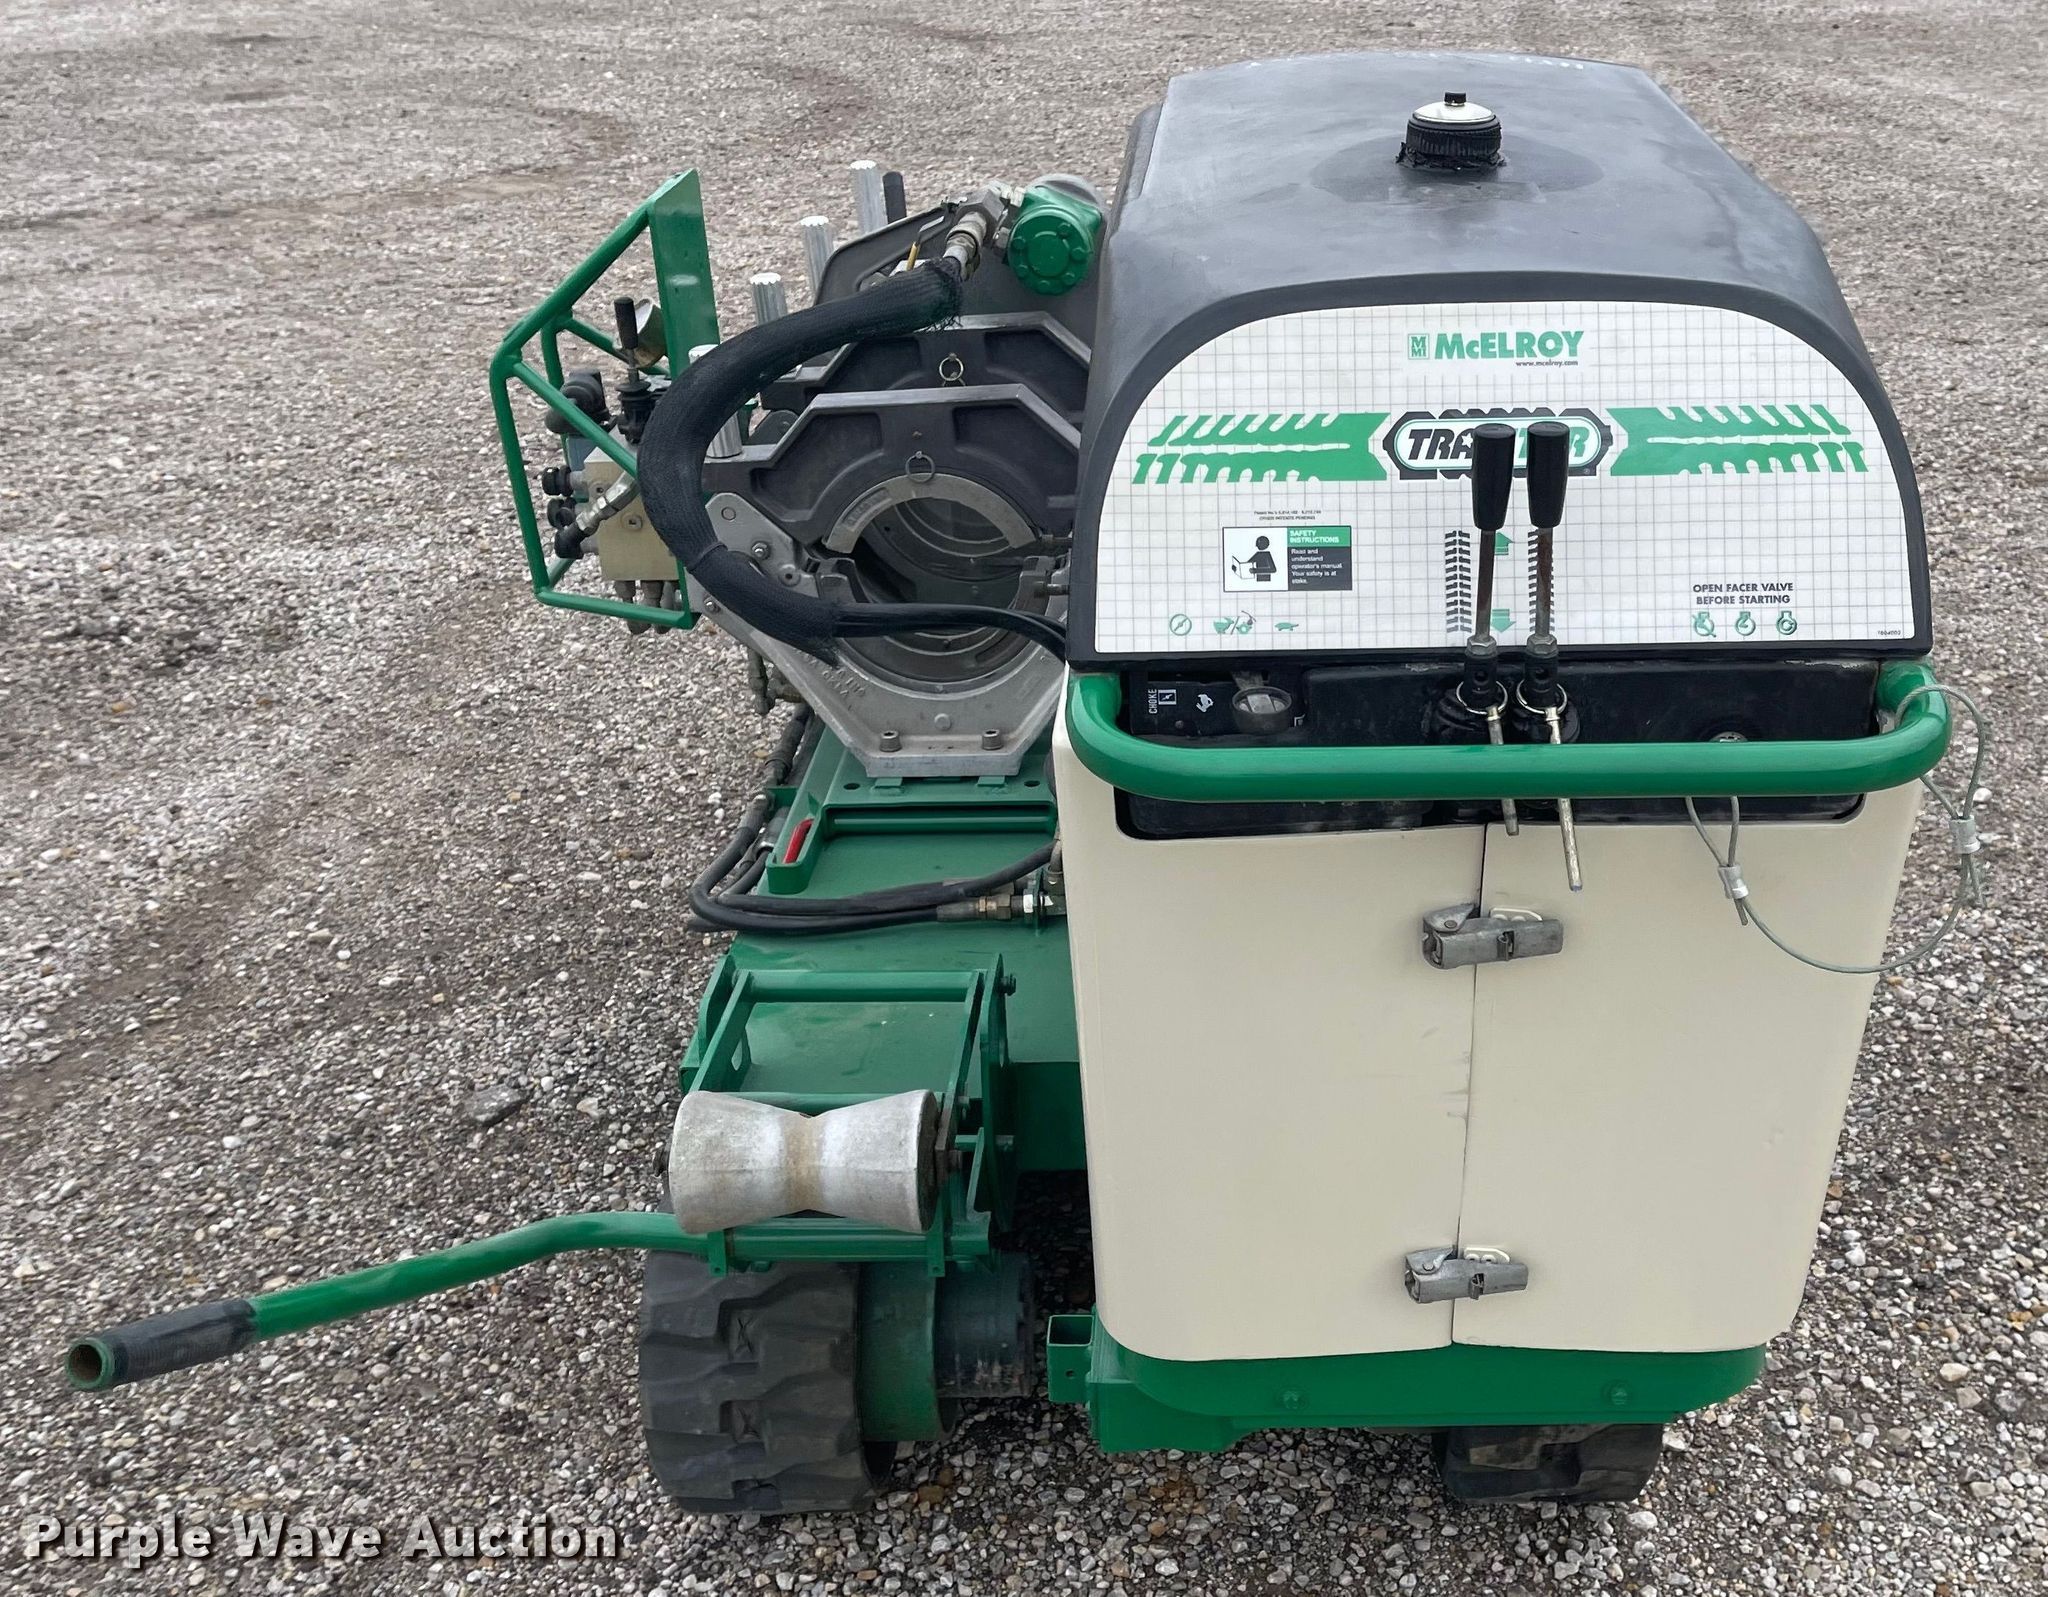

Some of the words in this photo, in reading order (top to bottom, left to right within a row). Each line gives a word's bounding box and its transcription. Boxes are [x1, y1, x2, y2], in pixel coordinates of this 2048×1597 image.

[1435, 331, 1584, 360] McELROY
[1516, 359, 1578, 368] www.mcelroy.com
[1693, 584, 1722, 592] OPEN
[1726, 583, 1758, 592] FACER
[1761, 583, 1793, 591] VALVE
[1696, 596, 1735, 605] BEFORE
[1739, 595, 1790, 604] STARTING
[1148, 688, 1158, 714] CHOKE
